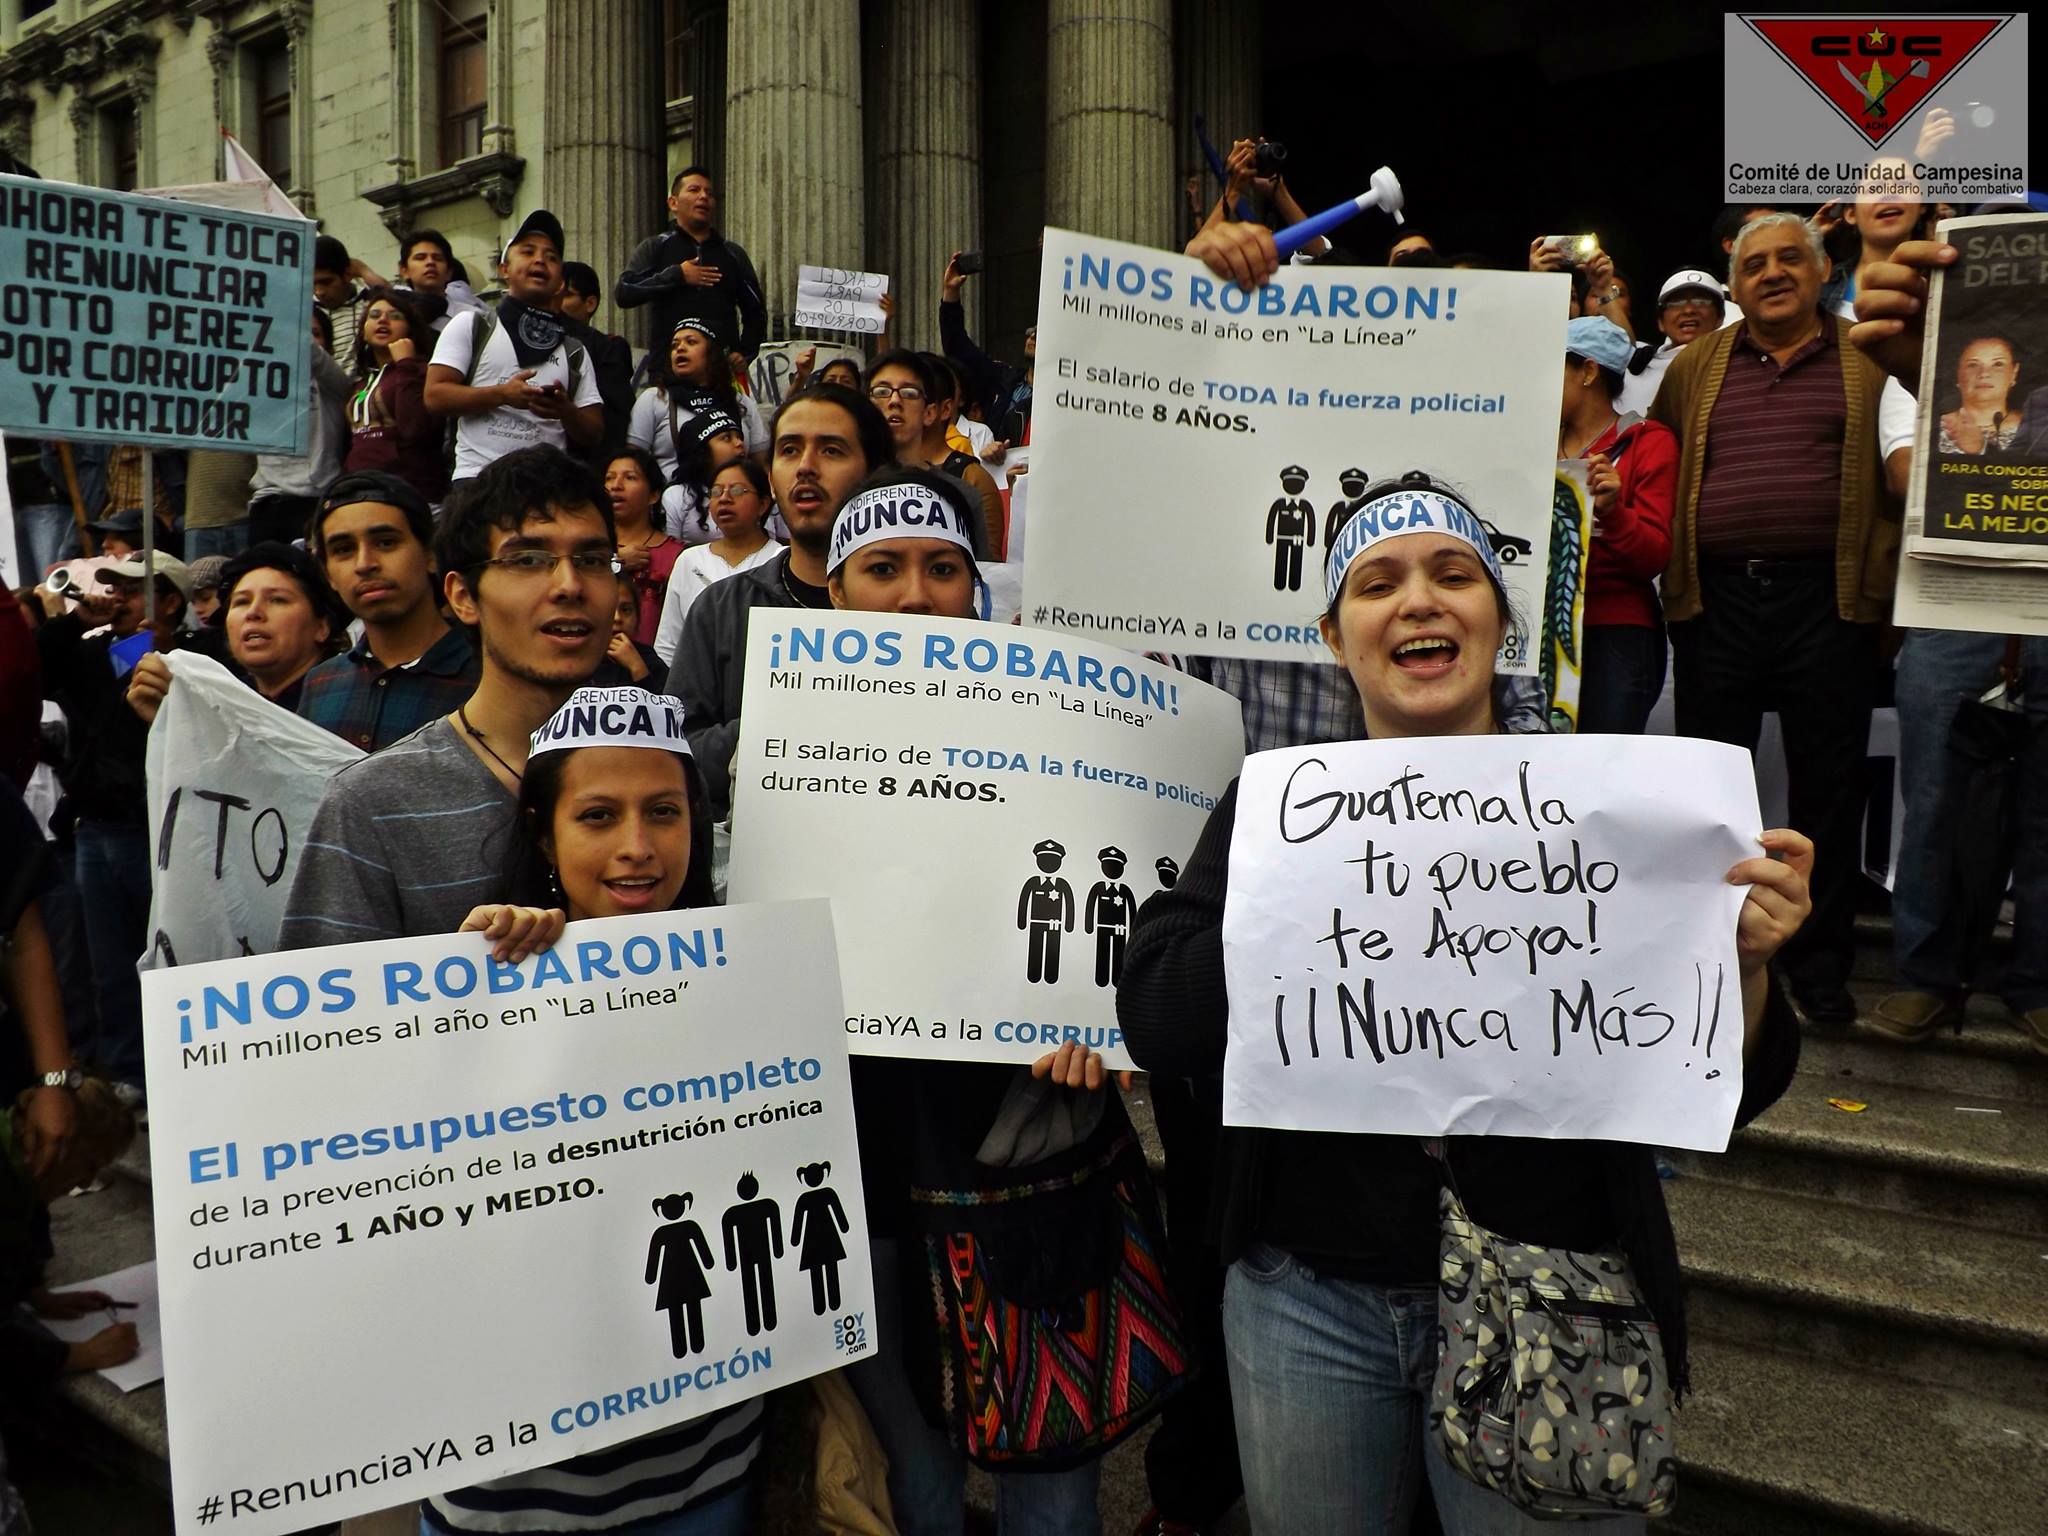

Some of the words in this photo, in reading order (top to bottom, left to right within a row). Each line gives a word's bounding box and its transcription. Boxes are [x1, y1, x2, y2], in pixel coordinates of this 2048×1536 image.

[0, 186, 124, 243] HORA
[137, 207, 188, 252] TE
[200, 218, 300, 268] TOCA
[26, 238, 267, 308] RENUNCIAR
[1063, 253, 1174, 301] ¡NOS
[1189, 277, 1458, 321] ROBARON!
[1964, 262, 2029, 287] DEL
[3, 284, 113, 335] OTTO
[148, 301, 274, 354] PEREZ
[1062, 293, 1091, 314] Mil
[1099, 301, 1184, 333] millones
[1191, 317, 1208, 336] al
[1214, 321, 1253, 343] año
[1262, 327, 1289, 343] en
[83, 341, 290, 400] CORRUPTO
[1058, 358, 1077, 378] El
[1086, 364, 1160, 393] salario
[1168, 375, 1195, 397] de
[1203, 381, 1277, 405] TODA
[1288, 387, 1310, 407] la
[1318, 389, 1401, 410] fuerza
[1411, 392, 1506, 415] policial
[32, 382, 57, 424] Y
[69, 386, 250, 440] TRAIDOR
[690, 398, 713, 406] USAC
[1056, 389, 1144, 421] durante
[1152, 404, 1168, 423] 8
[1175, 406, 1257, 434] AÑOS.
[1941, 463, 1980, 474] PARA
[1944, 513, 1975, 530] LA
[1965, 493, 1995, 510] ES
[1032, 606, 1187, 639] #RenunciaYA
[1194, 623, 1209, 639] a
[1217, 620, 1236, 640] la
[1246, 623, 1321, 645] CORR
[571, 689, 638, 705] ERENTES
[642, 691, 648, 703] Y
[769, 671, 801, 689] Mil
[812, 673, 915, 695] millones
[926, 679, 946, 697] al
[957, 682, 1001, 702] año
[1011, 690, 1040, 706] en
[770, 627, 901, 668] ¡NOS
[924, 633, 1180, 716] ROBARON!
[761, 772, 867, 795] durante
[878, 777, 897, 796] 8
[907, 774, 1006, 803] AÑOS.
[764, 739, 787, 758] El
[797, 741, 887, 763] salario
[899, 745, 932, 766] de
[942, 748, 1029, 773] TODA
[1040, 755, 1063, 775] la
[1072, 760, 1148, 792] fuerza
[1279, 758, 1575, 844] Guatemala
[1344, 839, 1411, 897] tu
[1427, 839, 1620, 911] pueblo
[1316, 907, 1394, 969] te
[1423, 899, 1603, 976] Apoya!
[178, 968, 356, 1043] ¡NOS
[383, 928, 728, 1006] ROBARON!
[182, 1042, 227, 1069] Mil
[242, 1024, 382, 1060] millones
[394, 1013, 421, 1038] al
[434, 1007, 489, 1035] año
[500, 1004, 536, 1027] en
[844, 1013, 921, 1038] ciaYA
[930, 1022, 946, 1039] a
[959, 1018, 982, 1040] la
[994, 1021, 1126, 1049] CORRUP
[189, 1143, 239, 1185] El
[262, 1090, 608, 1180] presupuesto
[622, 1053, 822, 1112] completo
[189, 1199, 229, 1227] de
[242, 1193, 270, 1219] la
[283, 1163, 455, 1217] prevención
[466, 1153, 502, 1180] de
[512, 1148, 536, 1172] la
[547, 1114, 725, 1165] desnutrición
[734, 1095, 823, 1130] crónica
[192, 1227, 322, 1270] durante
[335, 1221, 355, 1244] 1
[366, 1203, 444, 1241] AÑO
[455, 1203, 474, 1228] y
[486, 1177, 605, 1218] MEDIO.
[834, 1311, 864, 1334] SOY
[846, 1342, 867, 1356] .com
[197, 1437, 463, 1527] #RenunciaYA
[474, 1435, 497, 1456] a
[508, 1419, 538, 1449] la
[549, 1345, 773, 1436] CORRUPCIÓN
